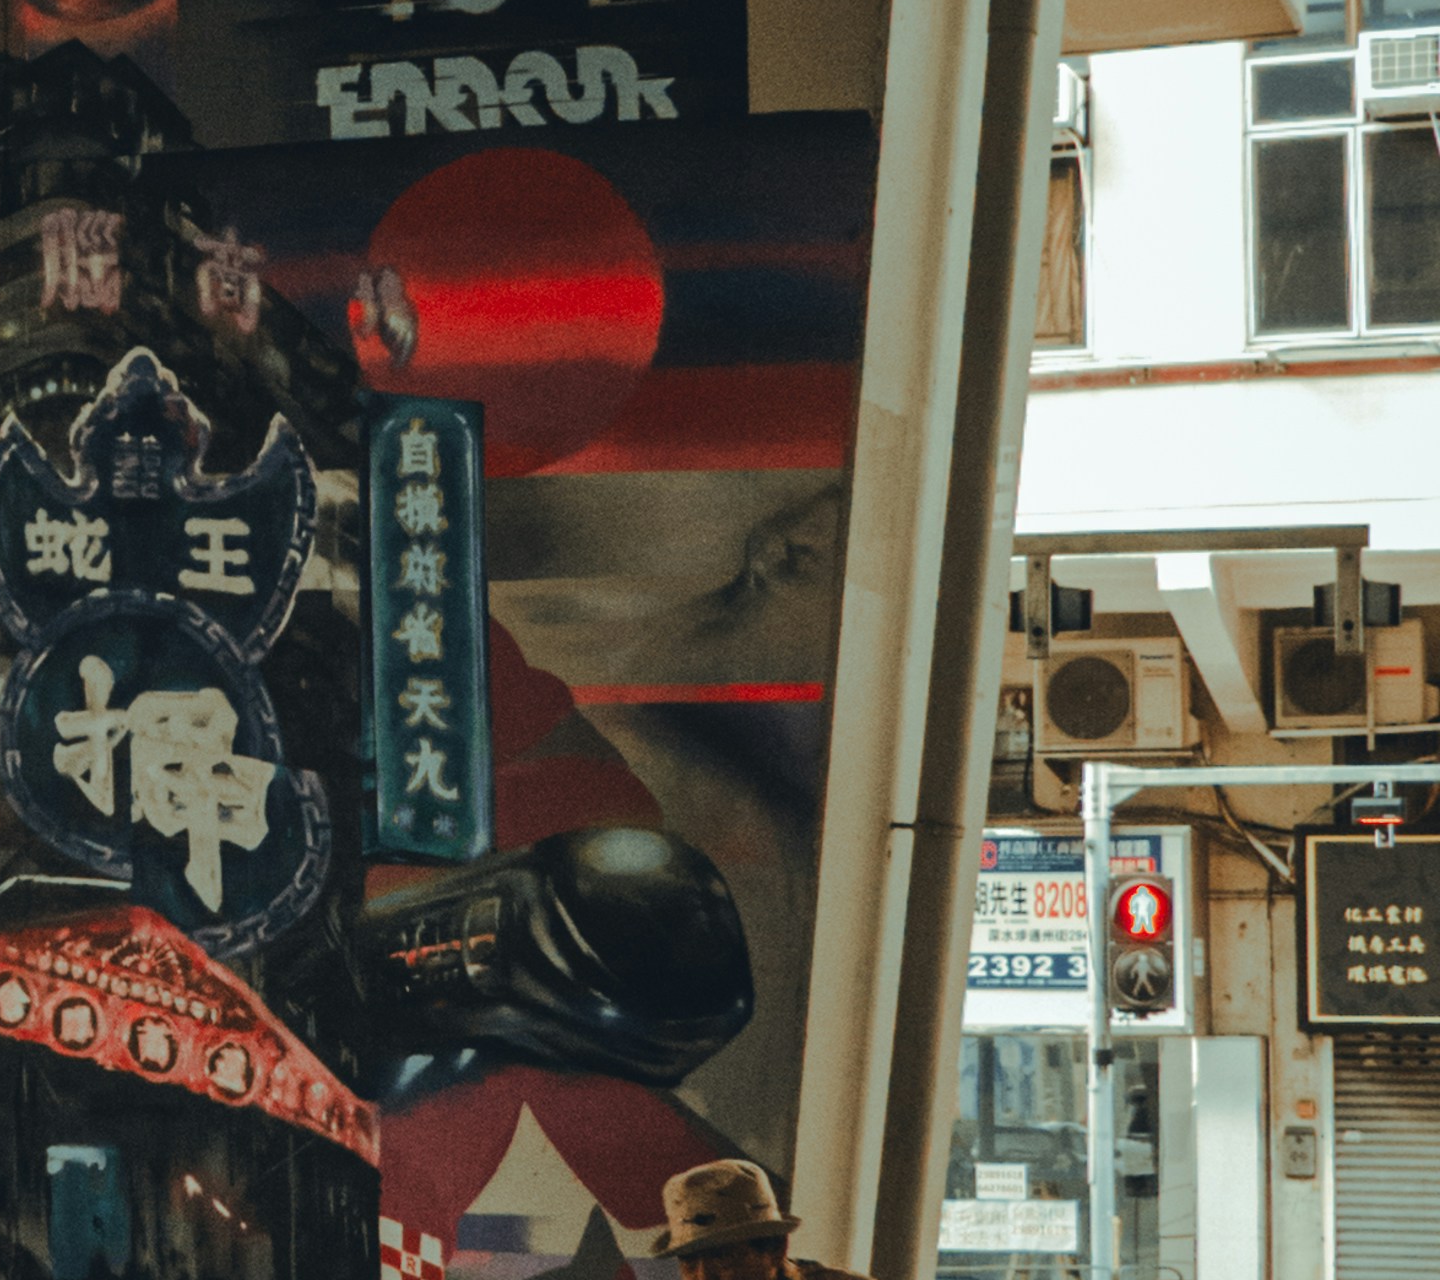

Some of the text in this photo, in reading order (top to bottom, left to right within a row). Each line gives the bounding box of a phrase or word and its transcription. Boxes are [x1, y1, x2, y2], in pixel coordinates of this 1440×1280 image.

[315, 45, 679, 140] ERROR
[23, 506, 257, 596] 蛇王
[969, 954, 1054, 978] 2392
